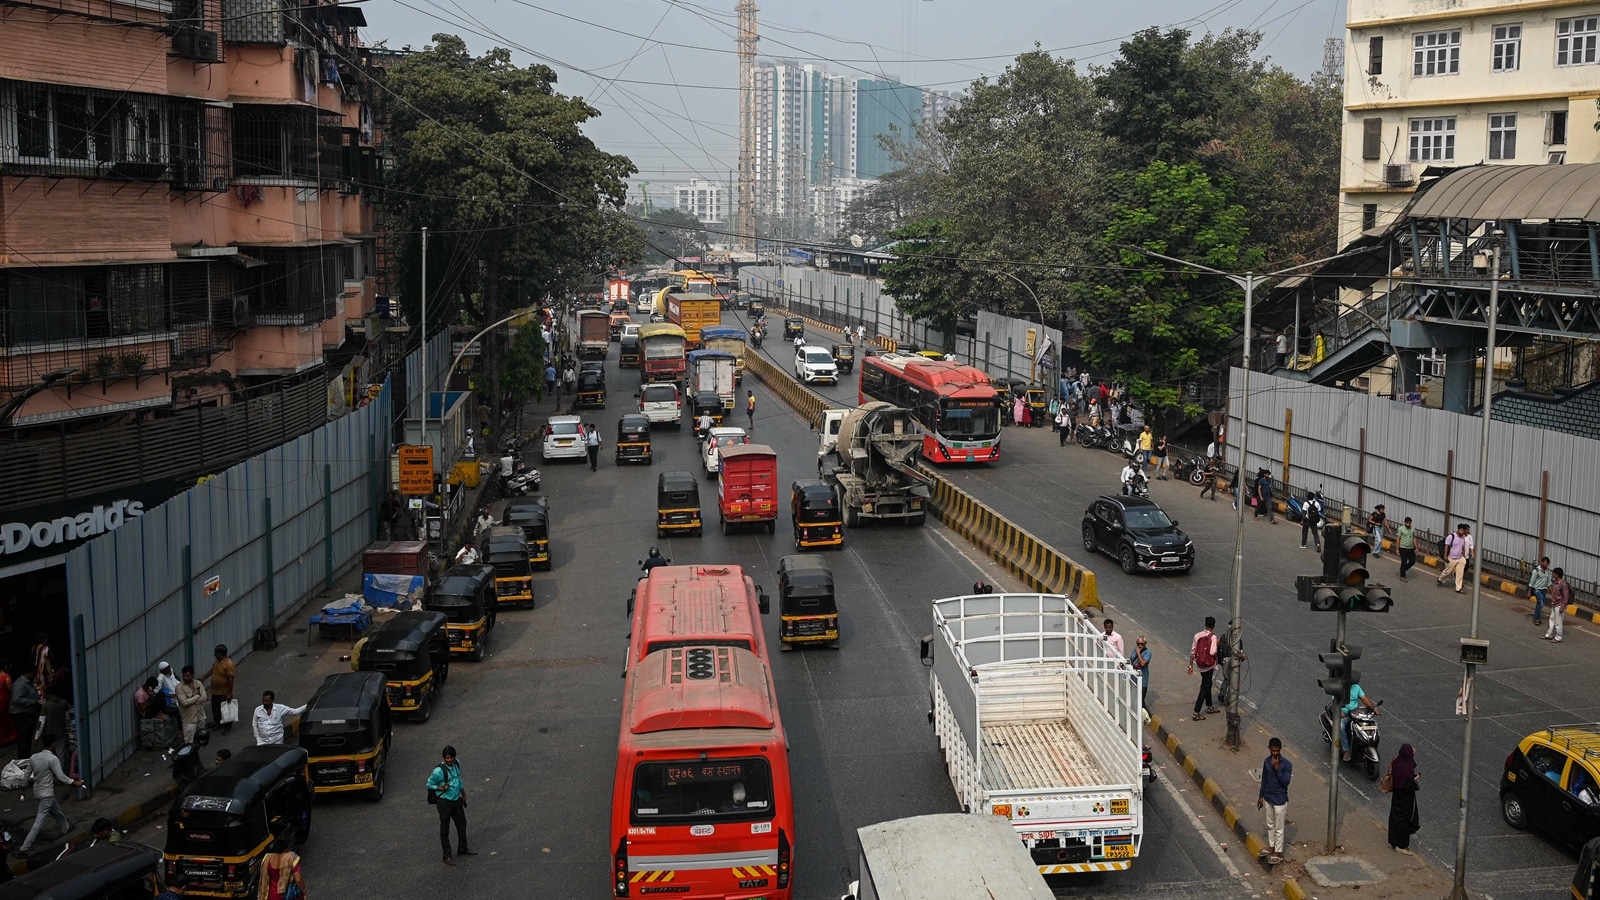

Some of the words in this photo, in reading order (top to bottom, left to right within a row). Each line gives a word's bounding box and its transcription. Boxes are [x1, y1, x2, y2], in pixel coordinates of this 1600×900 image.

[0, 499, 144, 554] Donald's
[1038, 831, 1055, 839] SIDE
[740, 880, 767, 888] TATA
